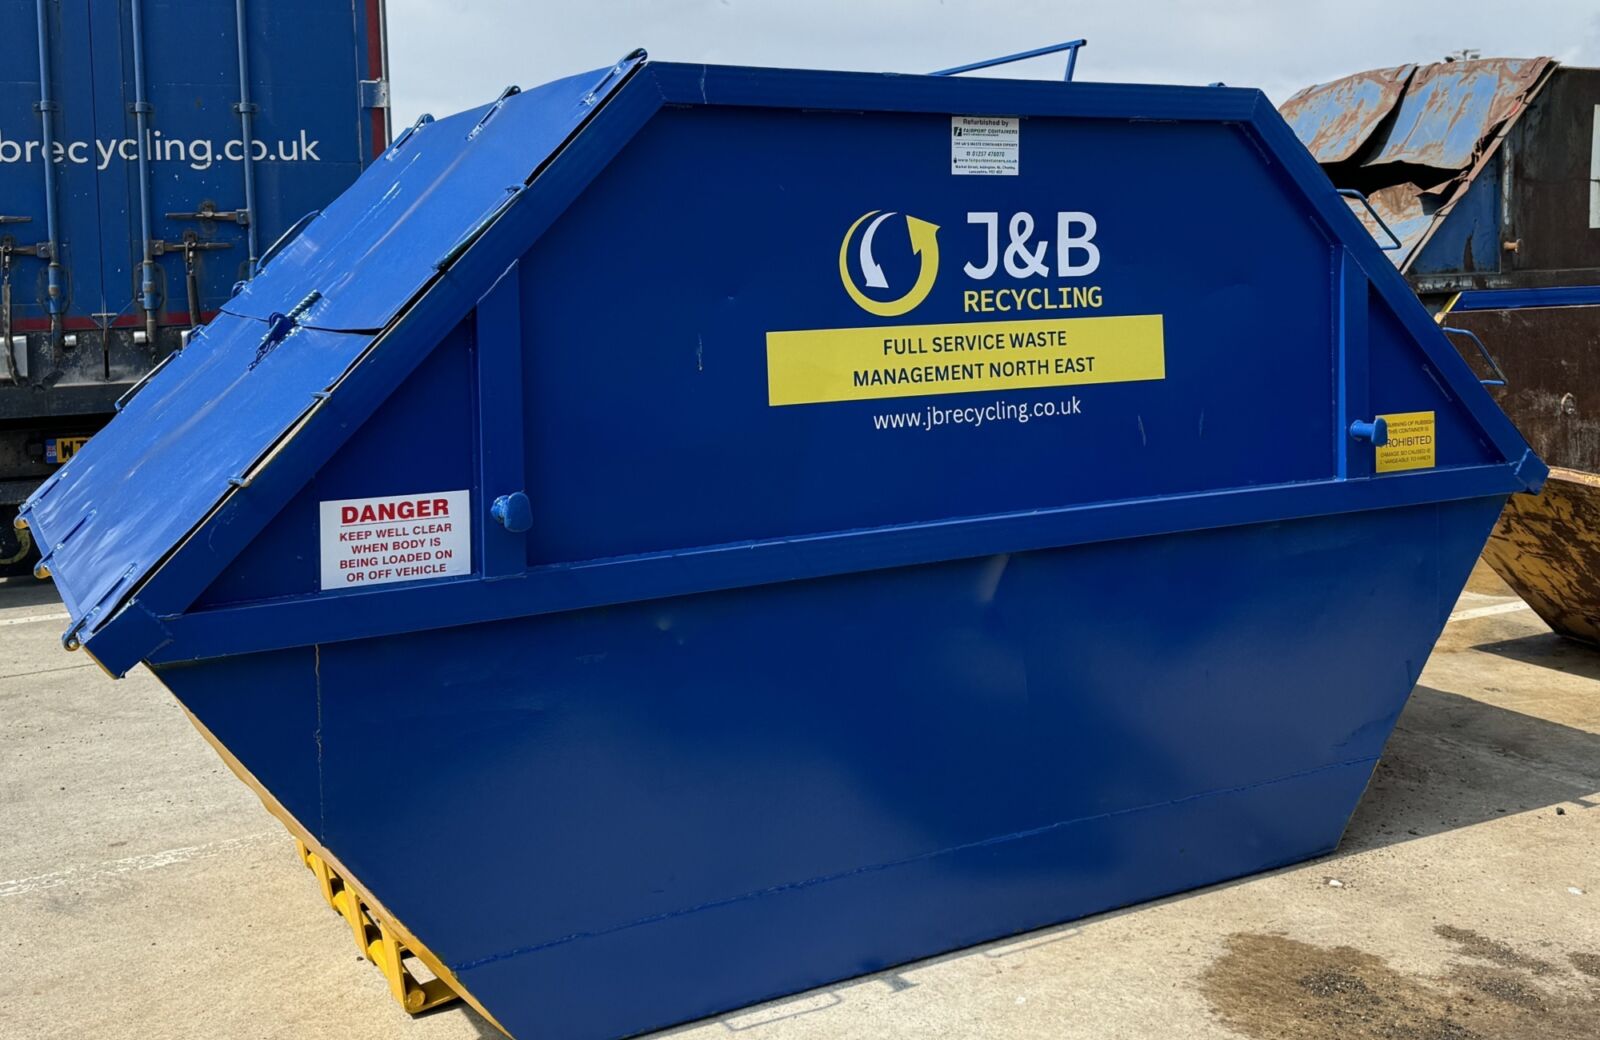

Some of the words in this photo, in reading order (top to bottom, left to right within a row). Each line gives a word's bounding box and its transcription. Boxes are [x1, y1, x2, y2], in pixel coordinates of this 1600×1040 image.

[964, 212, 1100, 280] J&B
[964, 286, 1102, 312] RECYCLING
[884, 338, 928, 355] FULL
[932, 334, 1005, 353] SERVICE
[1009, 331, 1067, 348] WASTE
[853, 363, 984, 386] MANAGEMENT
[989, 360, 1049, 378] NORTH
[1055, 356, 1095, 374] EAST
[873, 396, 1082, 431] www.jbrecycling.co.uk
[1385, 435, 1432, 448] ROHIBITED
[341, 499, 449, 524] DANGER
[340, 530, 372, 542] KEEP
[376, 527, 409, 538] WELL
[412, 523, 452, 535] CLEAR
[352, 542, 388, 554] WHEN
[392, 538, 426, 550] BODY
[430, 537, 441, 547] IS
[340, 557, 378, 569] BEING
[382, 552, 431, 565] LOADED
[435, 550, 452, 559] ON
[346, 572, 364, 582] OR
[368, 569, 392, 580] OFF
[395, 564, 446, 577] VEHICLE
